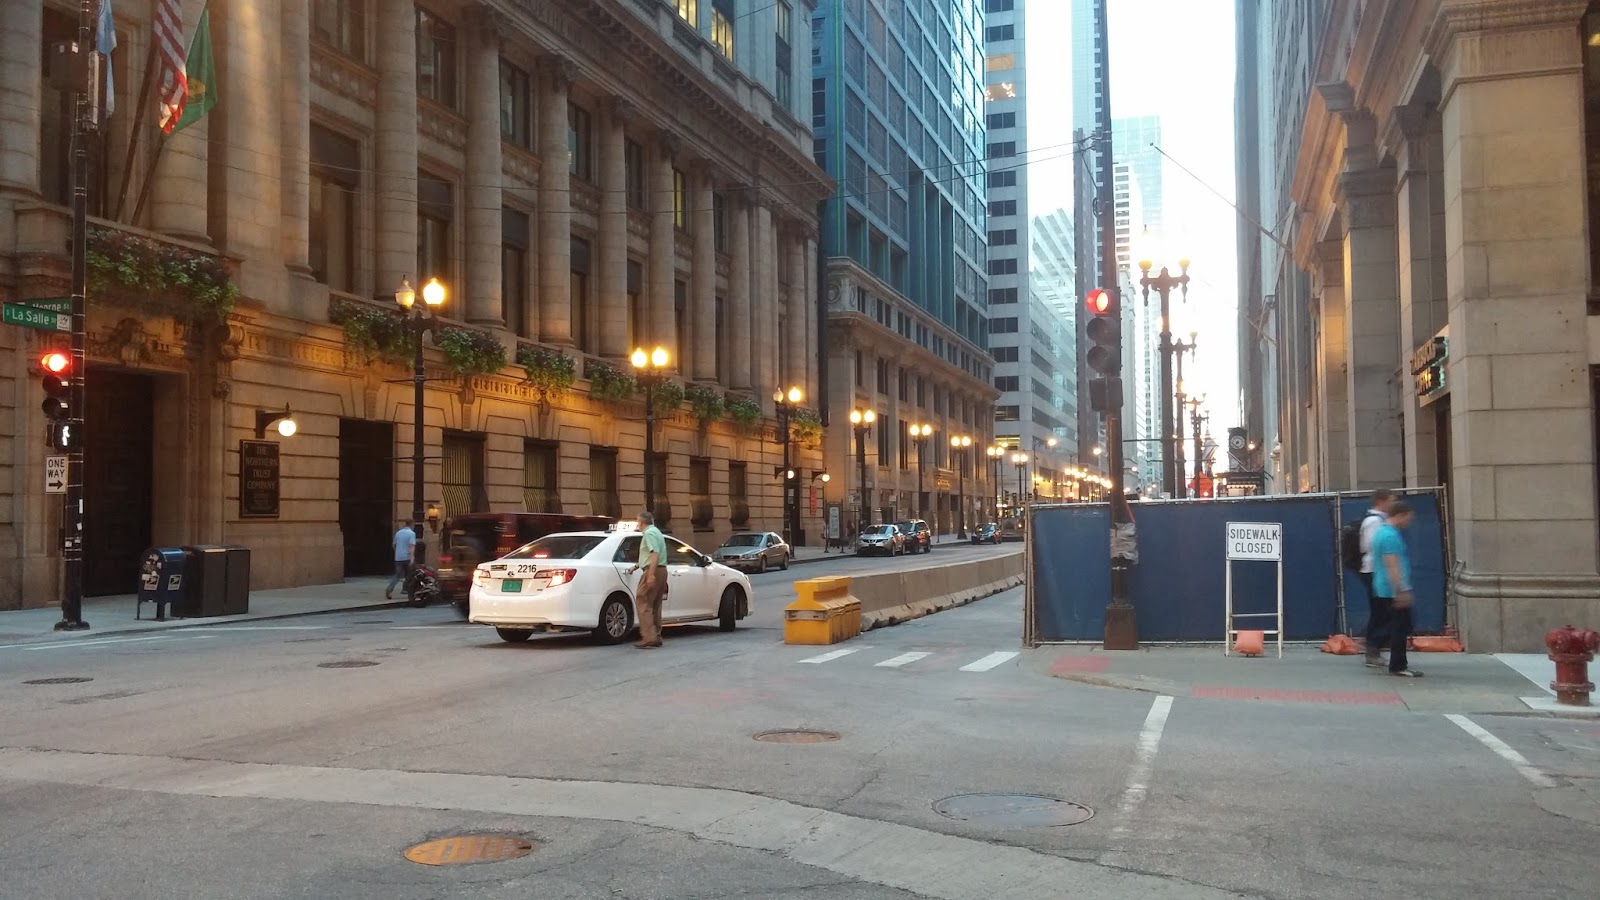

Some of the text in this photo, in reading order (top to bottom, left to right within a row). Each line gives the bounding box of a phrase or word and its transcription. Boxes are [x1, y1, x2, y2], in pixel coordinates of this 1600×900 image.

[12, 308, 23, 320] La
[26, 310, 50, 325] Salle
[48, 458, 65, 468] ONE
[48, 469, 65, 478] WAY
[1230, 528, 1278, 540] SIDEWALK
[1235, 542, 1273, 554] CLOSED
[517, 564, 537, 573] 2216
